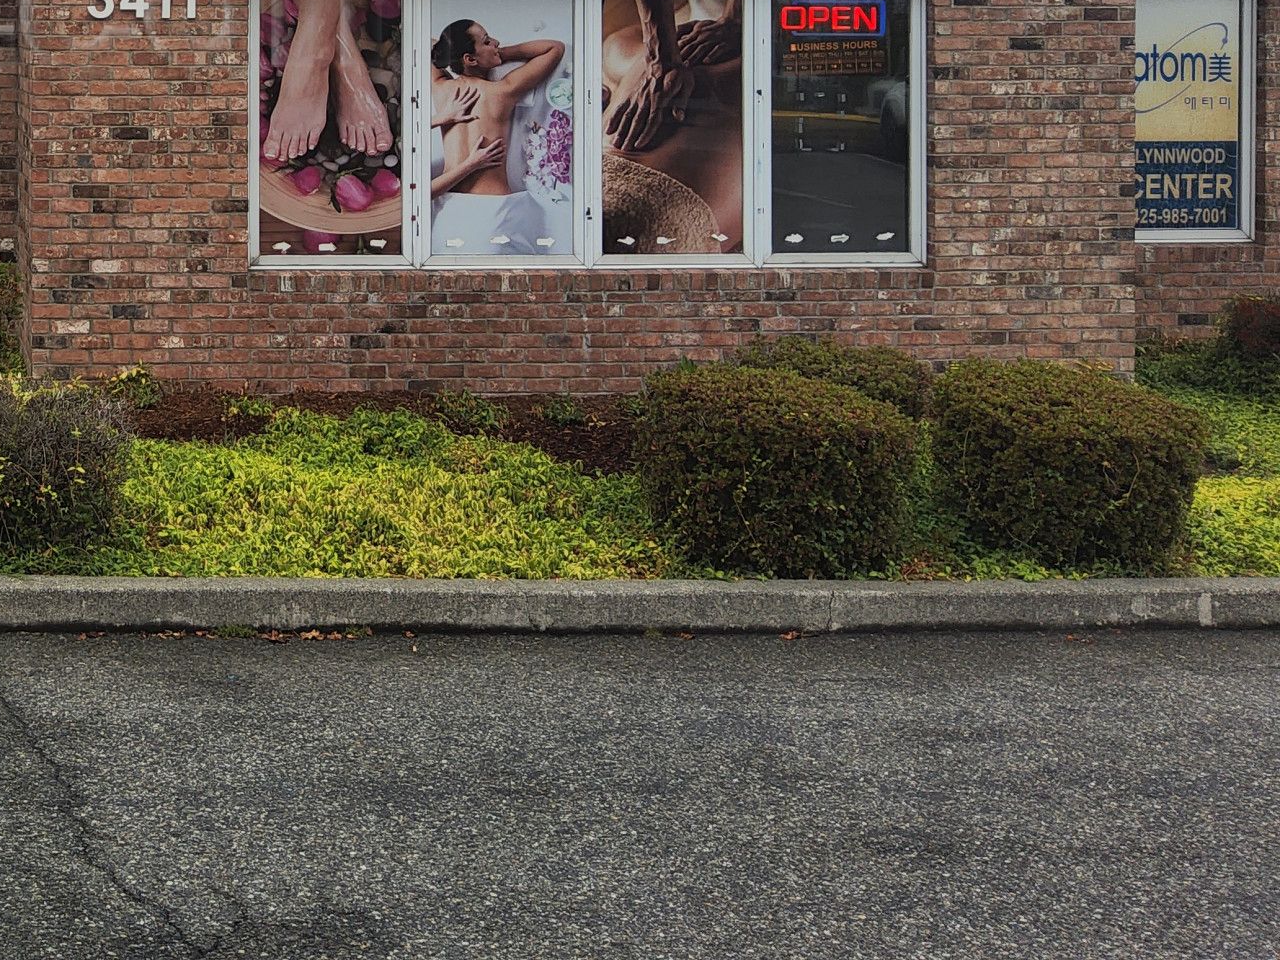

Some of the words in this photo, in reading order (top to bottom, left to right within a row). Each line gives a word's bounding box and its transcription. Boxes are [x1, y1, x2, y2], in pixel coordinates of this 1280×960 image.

[781, 6, 877, 31] OPEN
[842, 40, 878, 50] HOURS
[1136, 148, 1226, 164] LYNNWOOD
